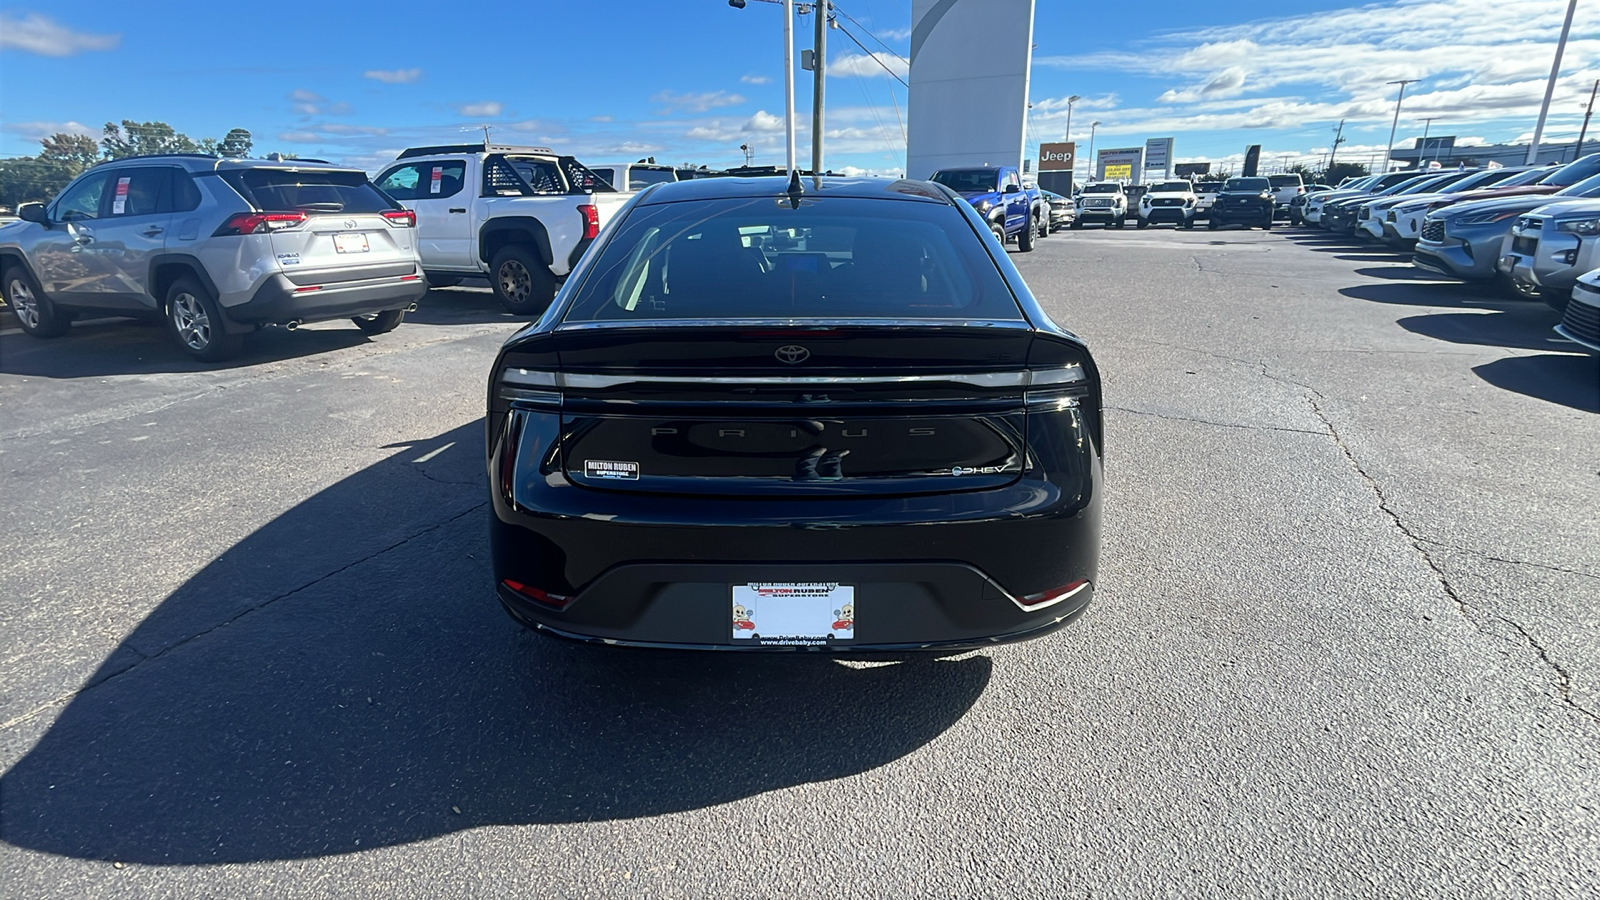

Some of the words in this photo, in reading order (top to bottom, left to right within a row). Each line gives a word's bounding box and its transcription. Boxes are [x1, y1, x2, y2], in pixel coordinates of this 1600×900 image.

[1041, 151, 1072, 162] Jeep
[651, 427, 936, 437] PRIUS
[588, 462, 612, 470] MILTON
[614, 463, 636, 471] RUBEN
